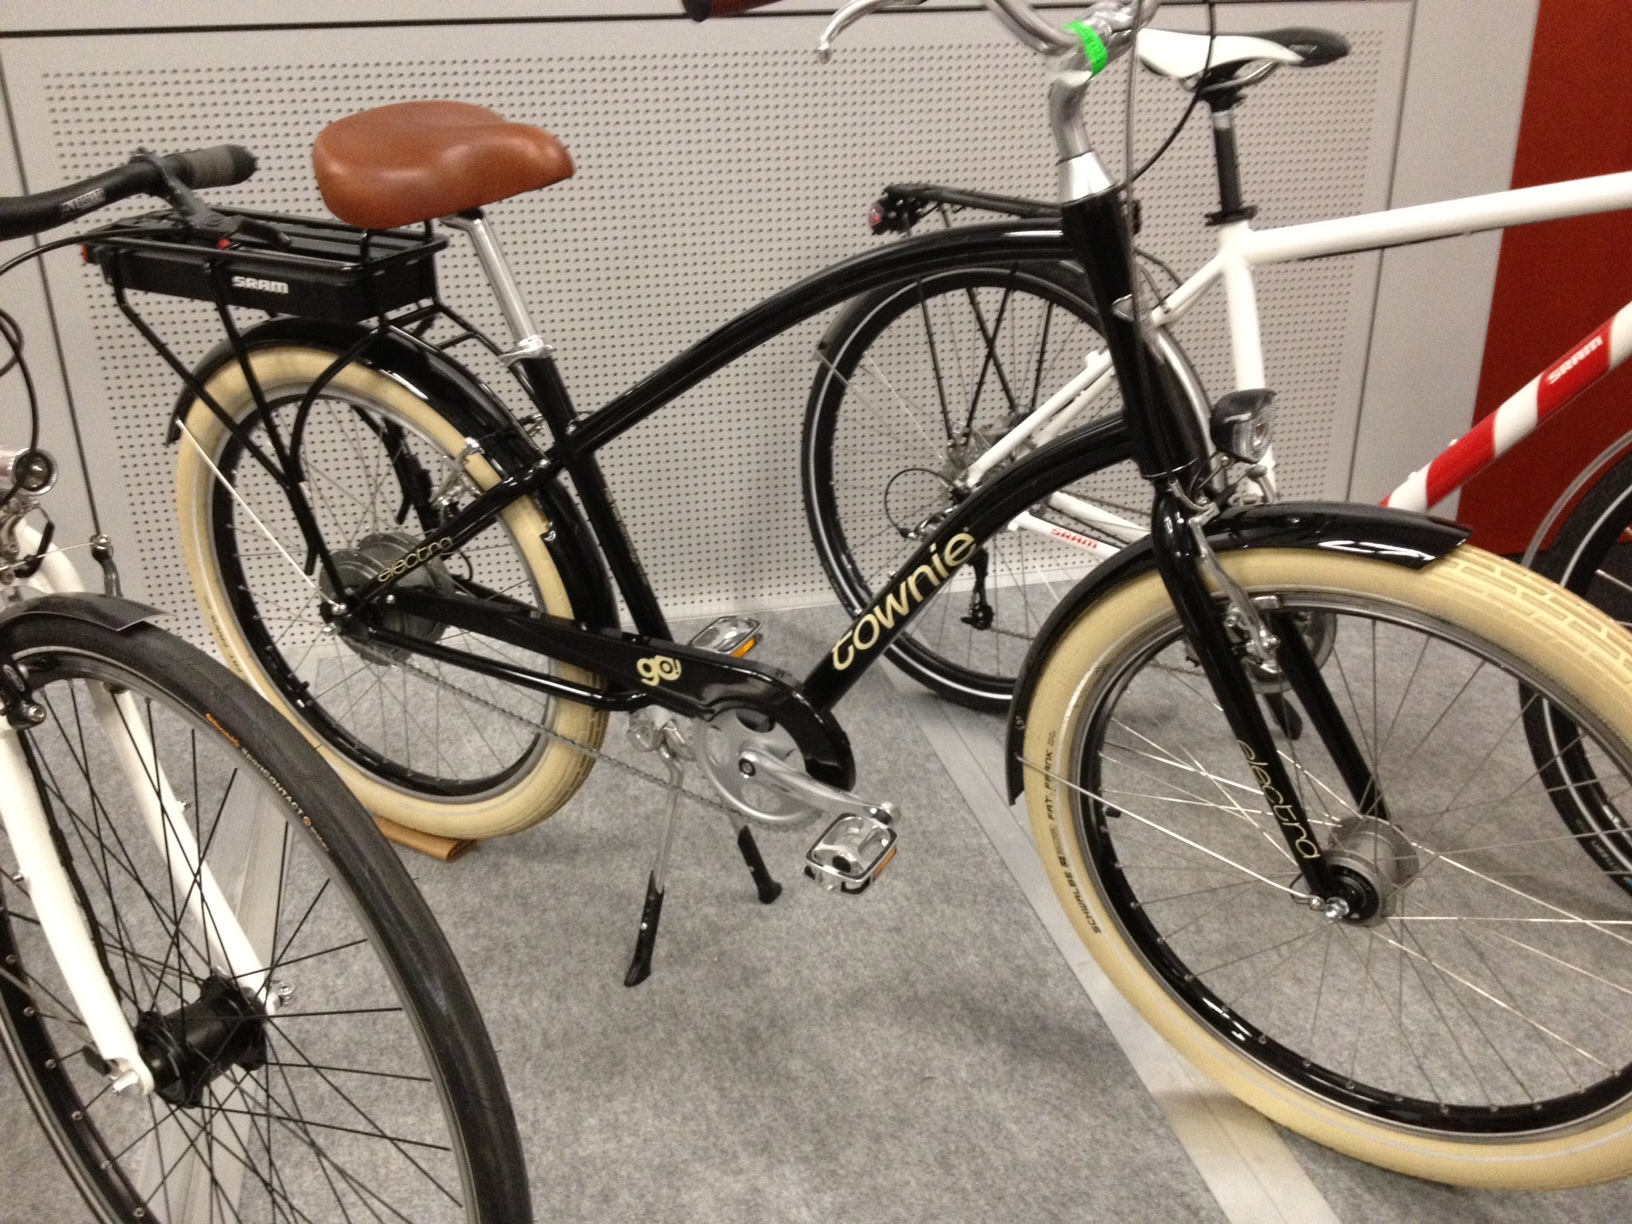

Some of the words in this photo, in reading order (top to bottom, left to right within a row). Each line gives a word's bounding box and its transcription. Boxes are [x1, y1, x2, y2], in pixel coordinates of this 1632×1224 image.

[231, 275, 290, 295] SRAM
[1546, 335, 1604, 386] SRAM
[1051, 528, 1098, 550] SRAM
[831, 532, 977, 671] townie
[1236, 739, 1322, 859] electra
[1063, 870, 1102, 934] SCHWALBE
